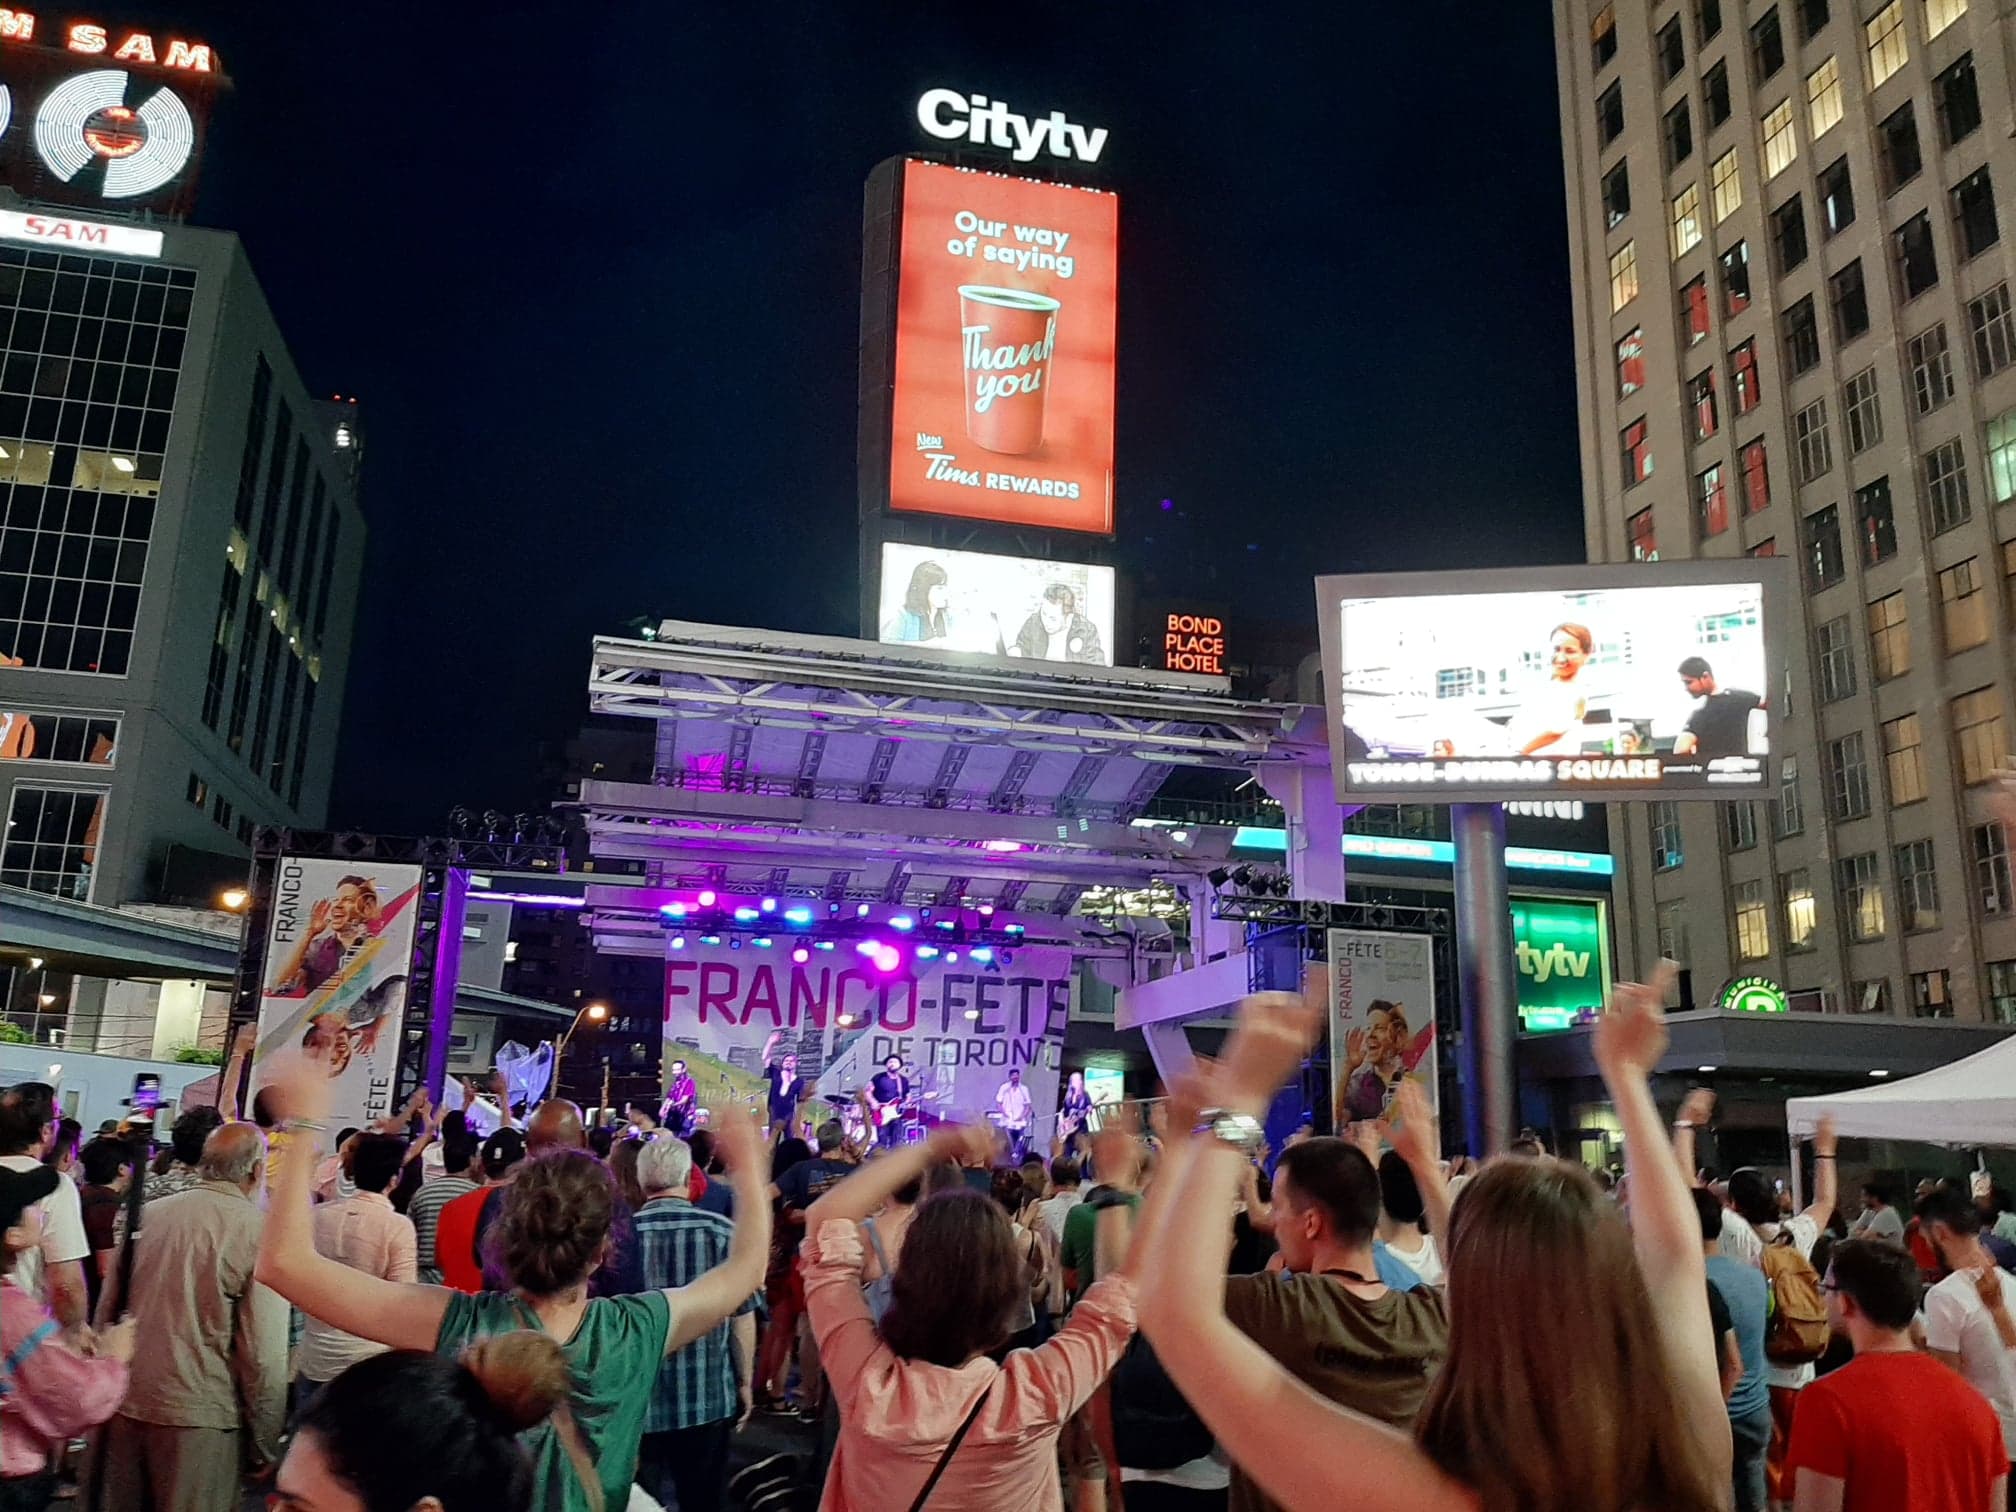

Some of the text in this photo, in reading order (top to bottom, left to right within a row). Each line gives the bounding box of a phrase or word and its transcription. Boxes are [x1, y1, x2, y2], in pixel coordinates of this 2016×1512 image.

[68, 25, 211, 72] SAM
[916, 88, 1109, 163] Citytv
[24, 216, 110, 245] SAM
[954, 210, 1070, 254] Our way
[947, 236, 1074, 279] of saying
[961, 316, 1056, 370] Thank
[974, 368, 1042, 414] you
[916, 432, 943, 450] New
[985, 472, 1080, 499] REWARDS
[1167, 613, 1222, 635] BOND
[1165, 632, 1224, 655] PLACE
[1166, 651, 1223, 674] HOTEL
[1556, 758, 1662, 781] SQUARE
[1338, 957, 1353, 1020] FRANCO
[872, 1036, 914, 1067] DE
